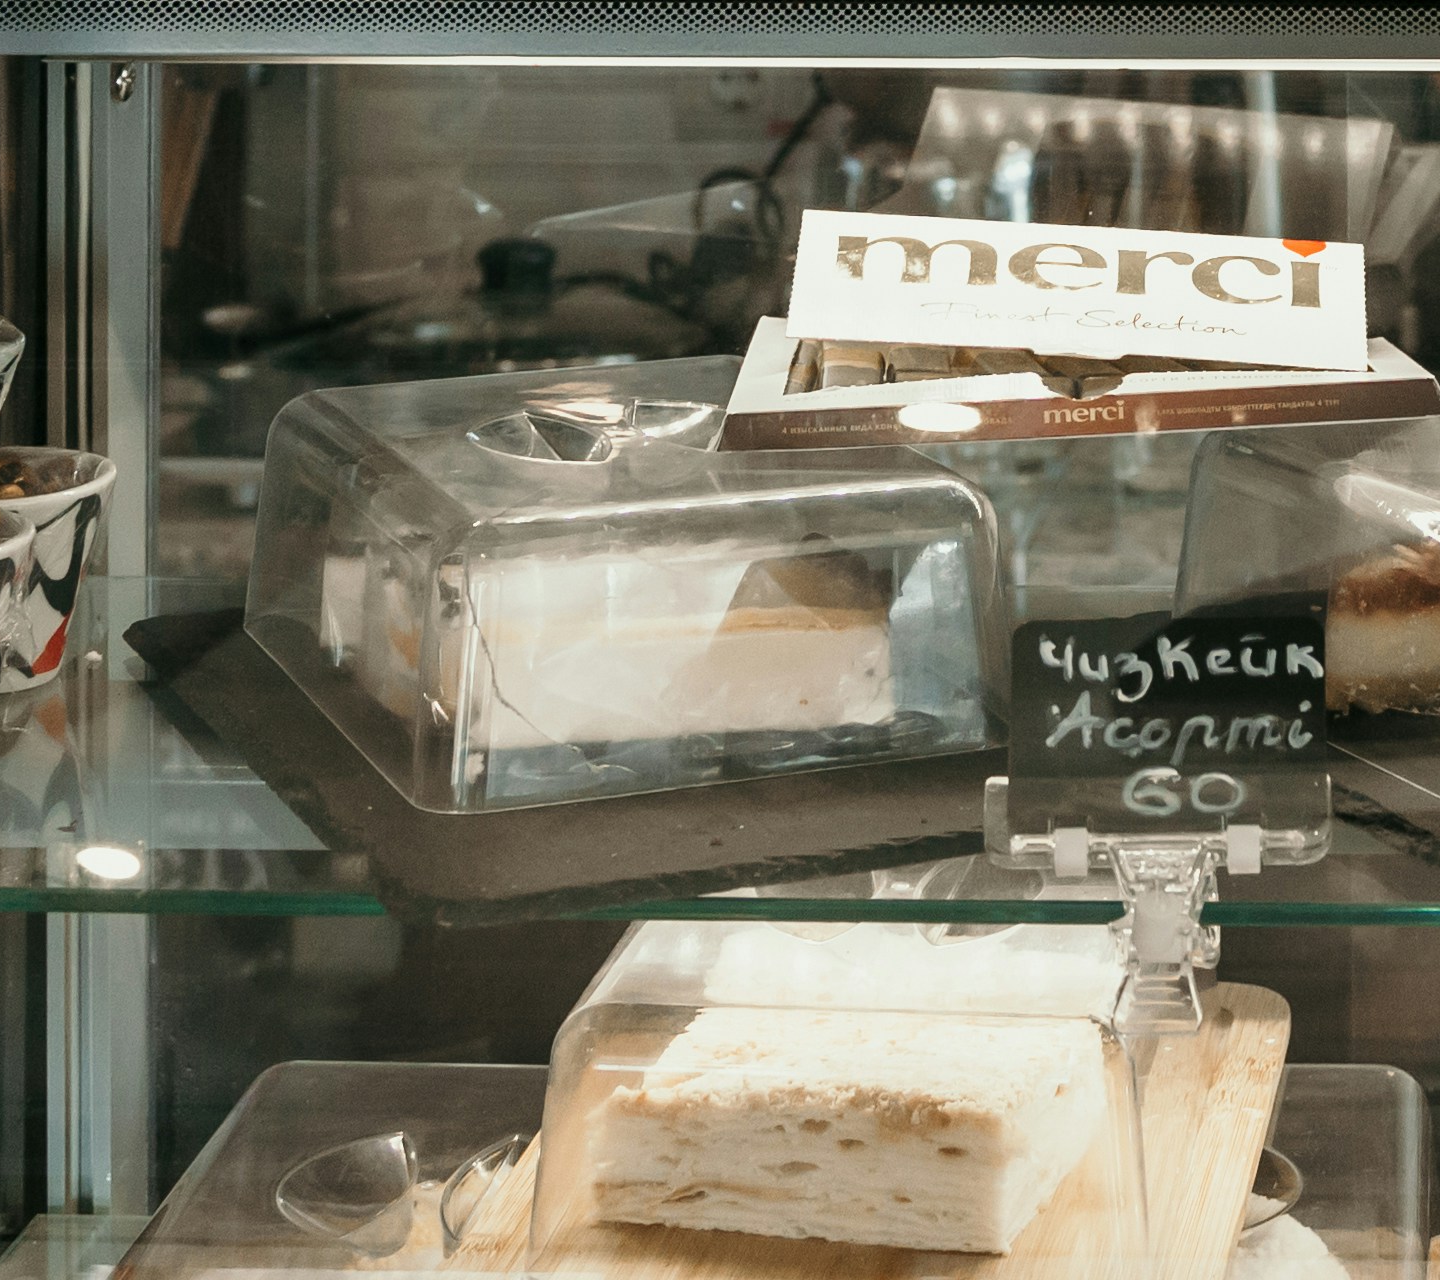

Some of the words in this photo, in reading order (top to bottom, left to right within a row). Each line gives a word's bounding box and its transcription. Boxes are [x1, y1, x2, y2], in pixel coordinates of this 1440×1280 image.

[836, 235, 1327, 309] merci
[1076, 307, 1248, 339] Selection
[1043, 399, 1125, 425] merci
[1122, 767, 1246, 816] 60
